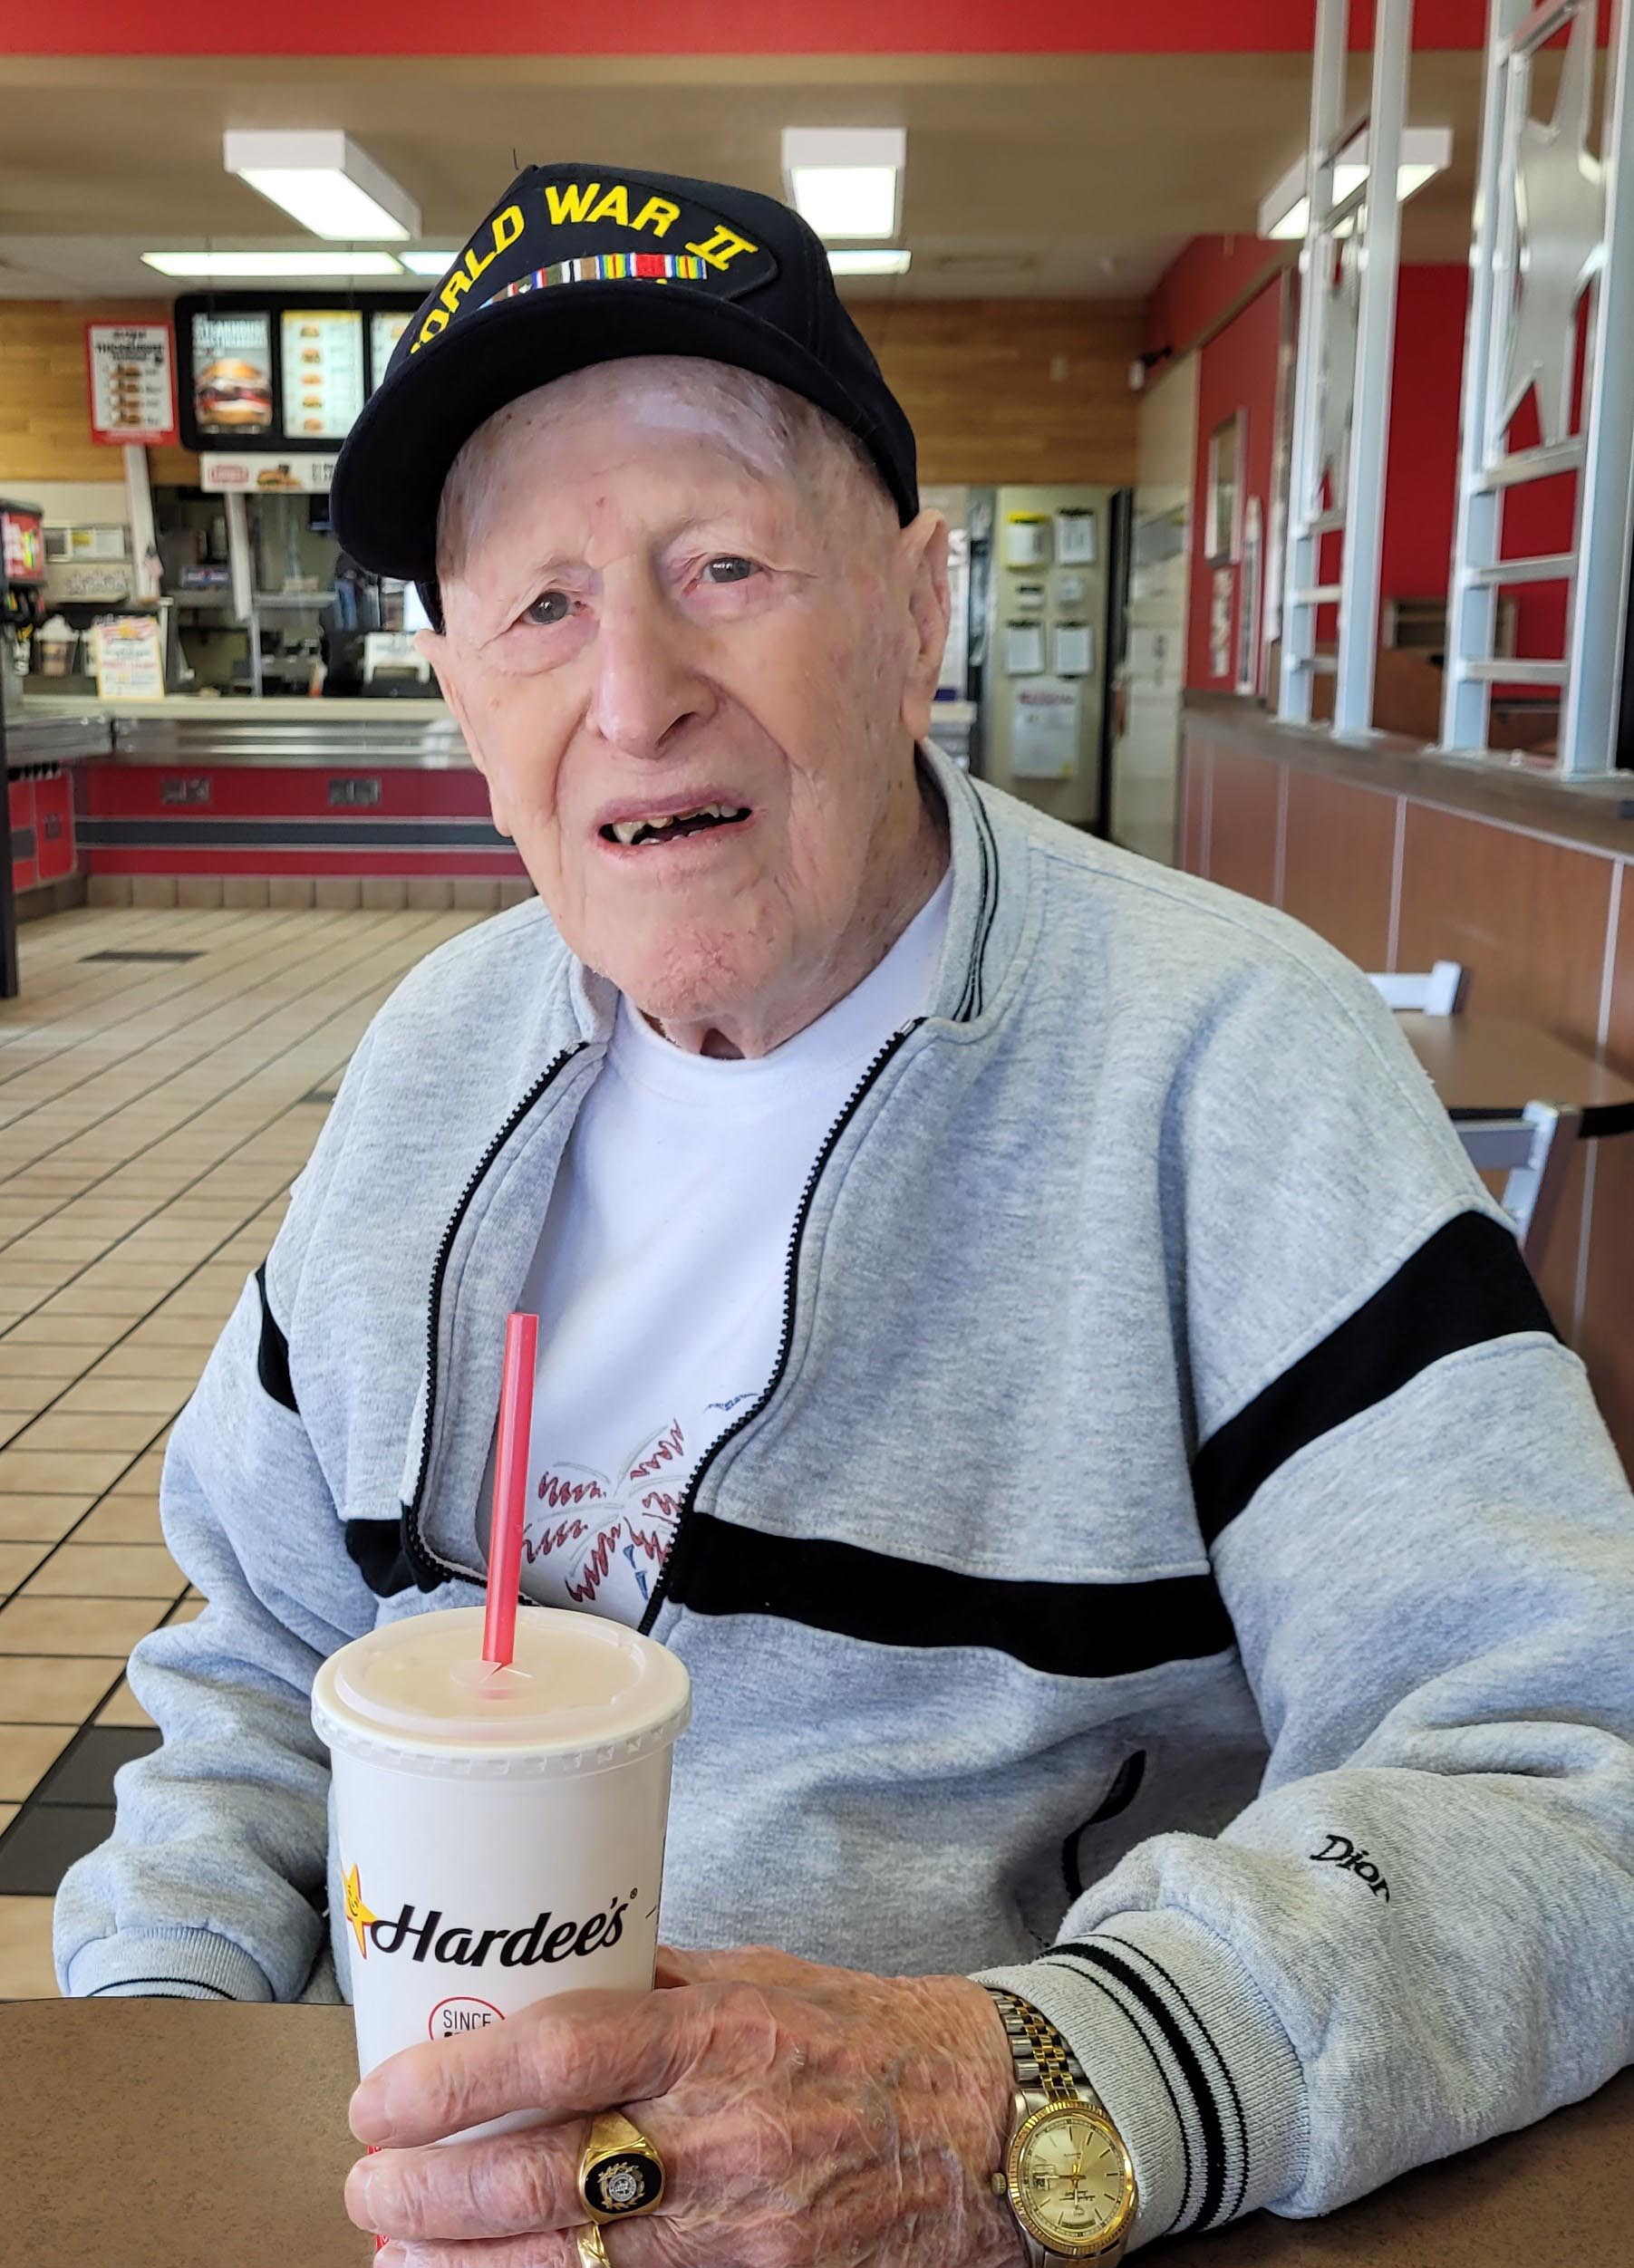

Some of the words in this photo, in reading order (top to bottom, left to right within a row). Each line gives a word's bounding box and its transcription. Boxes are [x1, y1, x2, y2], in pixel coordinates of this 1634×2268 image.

[411, 205, 526, 354] ORLD
[545, 183, 681, 237] WAR
[685, 224, 759, 271] II
[1309, 1834, 1390, 1903] Dior
[371, 1896, 629, 1967] Hardee's
